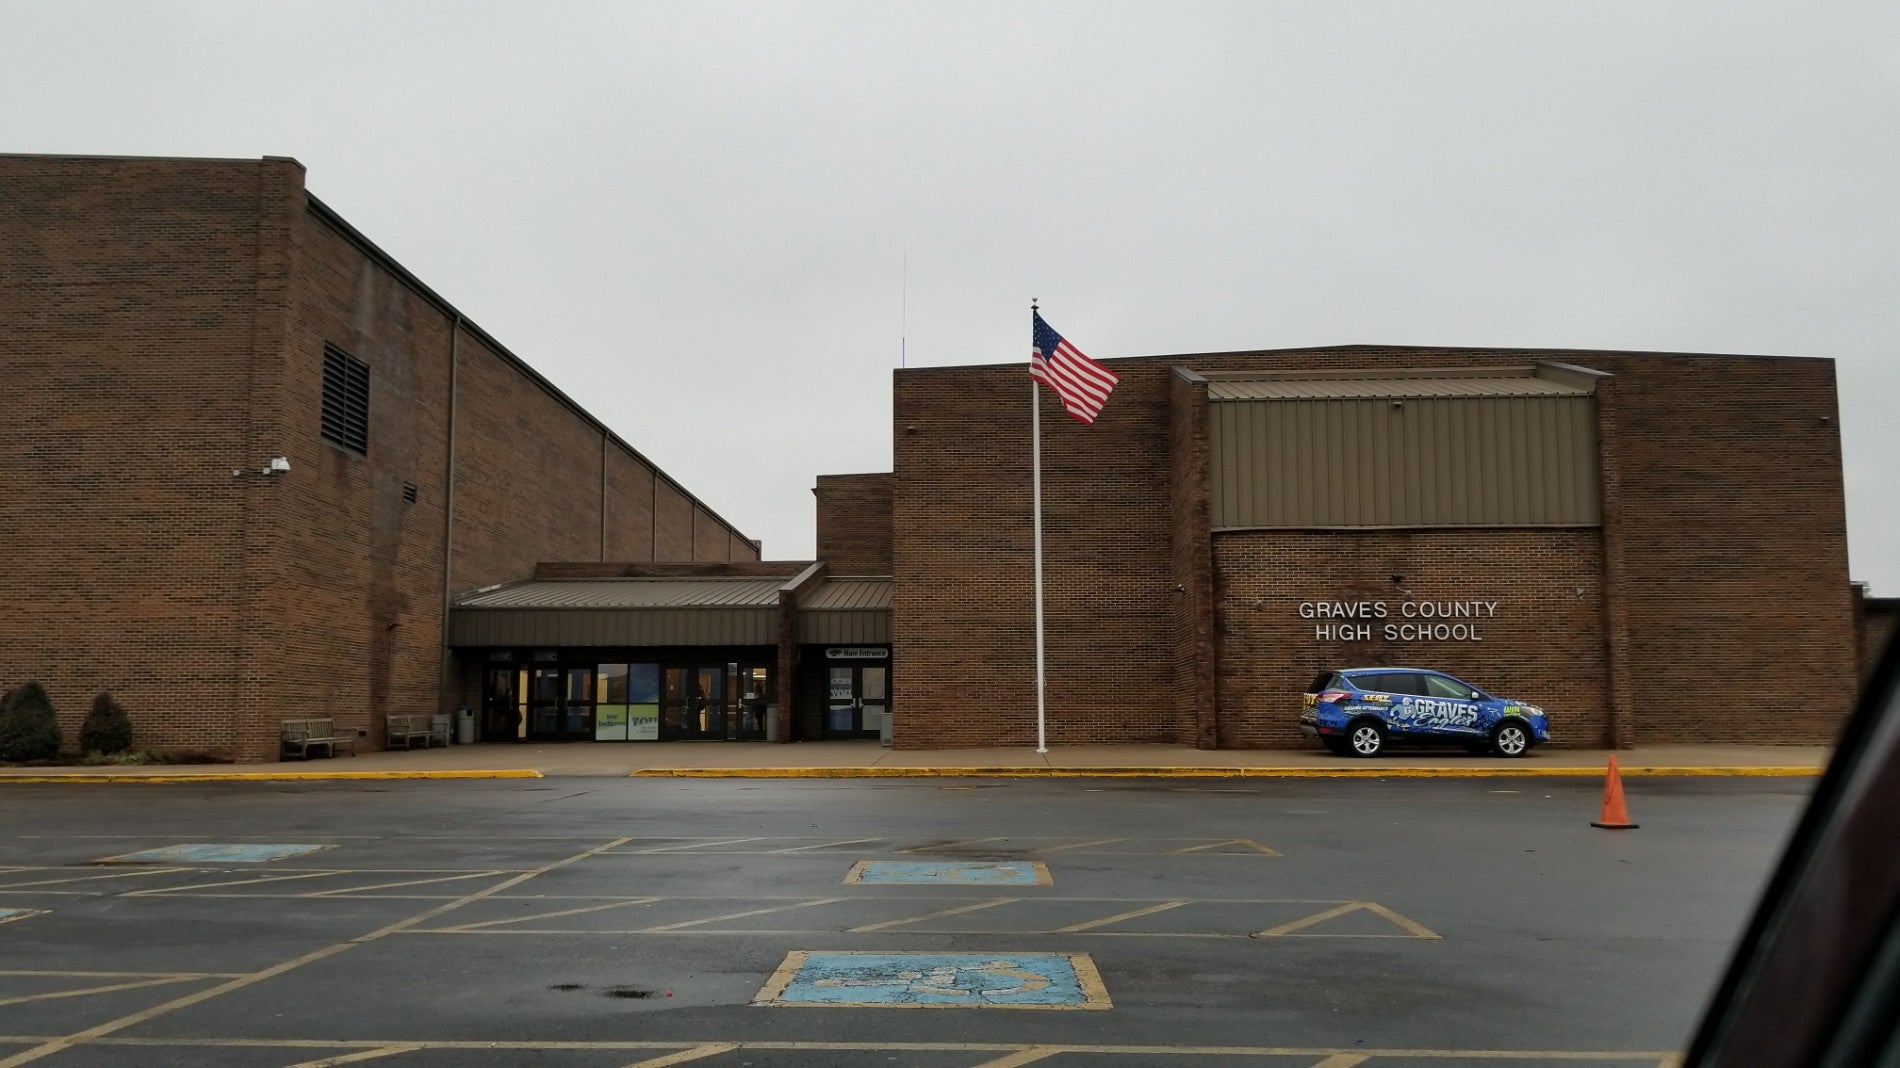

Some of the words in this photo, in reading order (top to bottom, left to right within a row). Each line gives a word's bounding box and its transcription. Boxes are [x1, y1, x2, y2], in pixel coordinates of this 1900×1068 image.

[1299, 602, 1388, 618] GRAVES
[1402, 602, 1498, 618] COUNTY
[1316, 624, 1371, 641] HIGH
[1384, 624, 1482, 641] SCHOOL
[844, 649, 859, 657] Main
[860, 649, 887, 657] Entrance
[1415, 699, 1478, 722] GRAVES
[1413, 712, 1473, 728] Eagles
